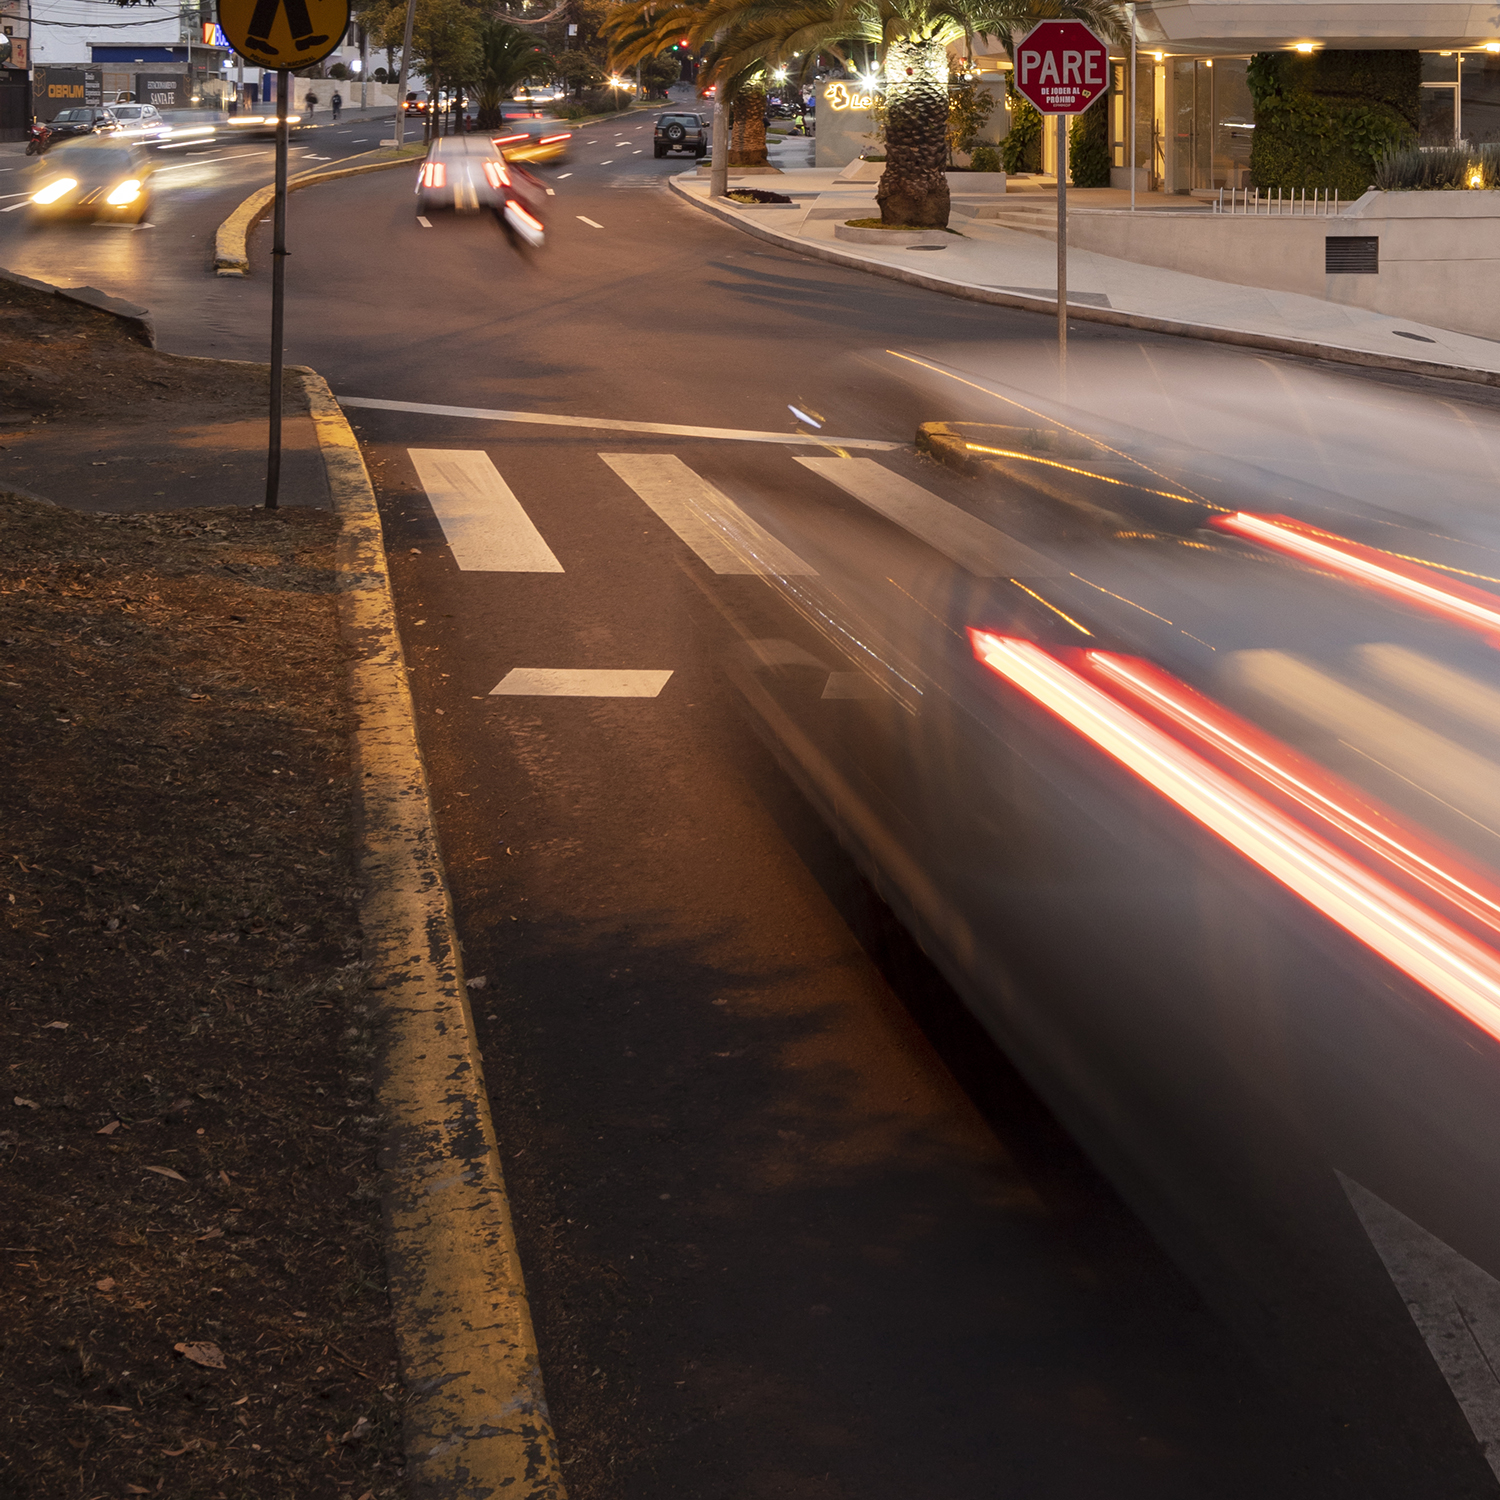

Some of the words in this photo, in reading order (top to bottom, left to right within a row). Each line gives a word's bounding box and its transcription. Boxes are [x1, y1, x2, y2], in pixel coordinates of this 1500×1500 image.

[1021, 50, 1103, 85] PARE
[48, 84, 84, 98] OBRUM
[1041, 87, 1050, 95] DE
[1051, 87, 1071, 95] JODER
[1072, 86, 1081, 94] AL
[150, 92, 167, 104] SANTA
[167, 91, 175, 104] FE
[851, 93, 872, 110] Le
[1046, 95, 1076, 104] PRÓJIMO
